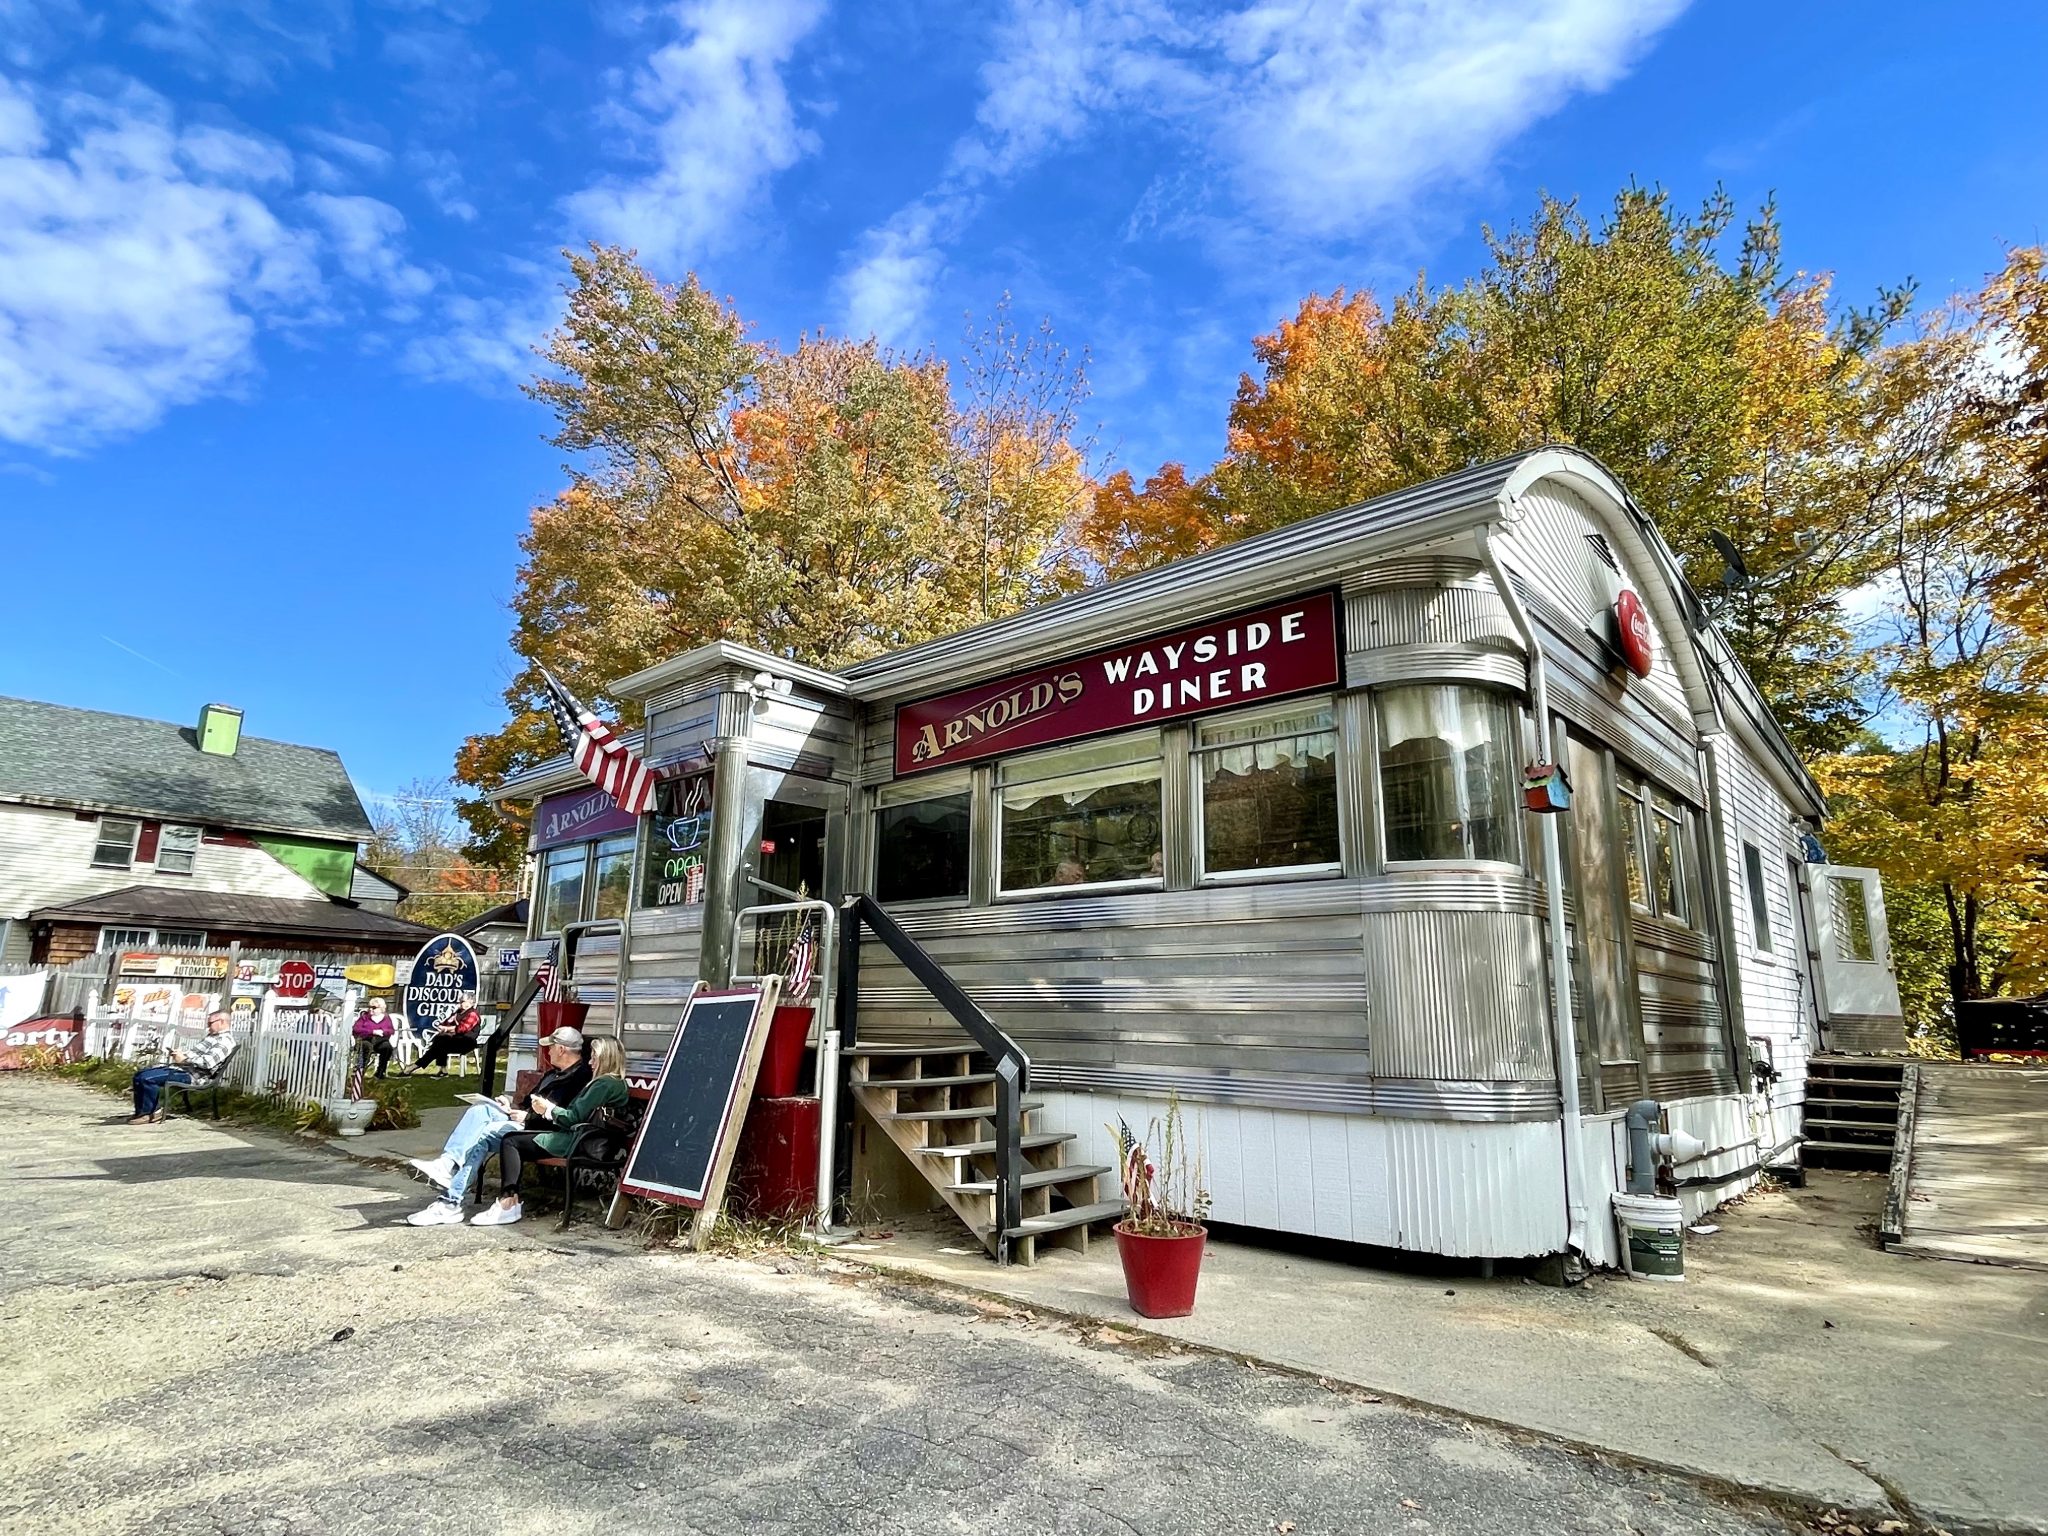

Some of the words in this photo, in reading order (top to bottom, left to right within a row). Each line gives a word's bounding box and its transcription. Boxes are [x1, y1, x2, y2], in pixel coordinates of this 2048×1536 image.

[1103, 611, 1306, 685] WAYSIDE
[1132, 662, 1267, 716] DINER
[911, 671, 1084, 763] ARNOLD'S
[545, 793, 617, 839] ARNOLD
[658, 882, 683, 905] OPEN
[274, 973, 313, 989] STOP
[425, 972, 464, 988] DAD'S
